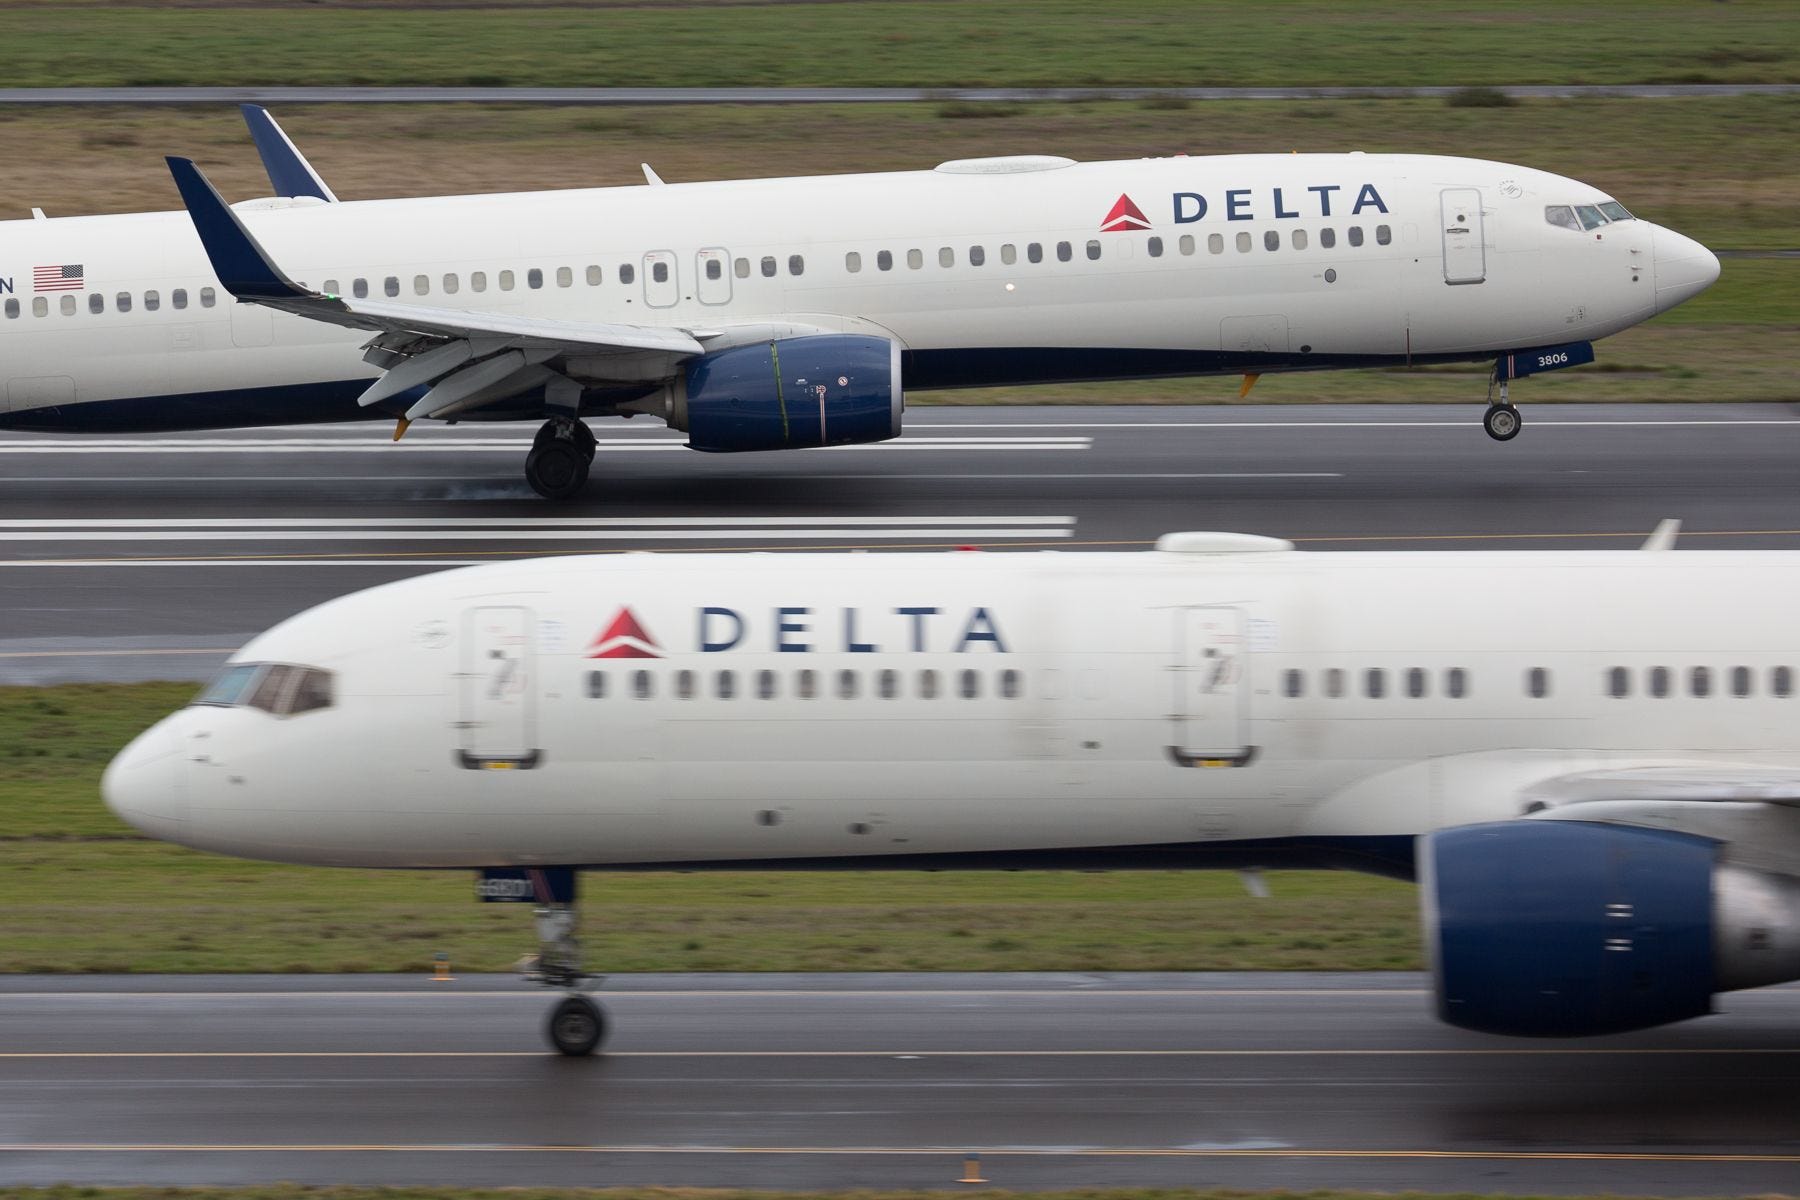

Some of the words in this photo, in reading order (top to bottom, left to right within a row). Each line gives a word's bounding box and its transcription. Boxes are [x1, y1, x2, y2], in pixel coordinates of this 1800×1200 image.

[1173, 183, 1390, 224] DELTA
[1538, 352, 1568, 367] 3806
[695, 607, 1011, 654] DELTA
